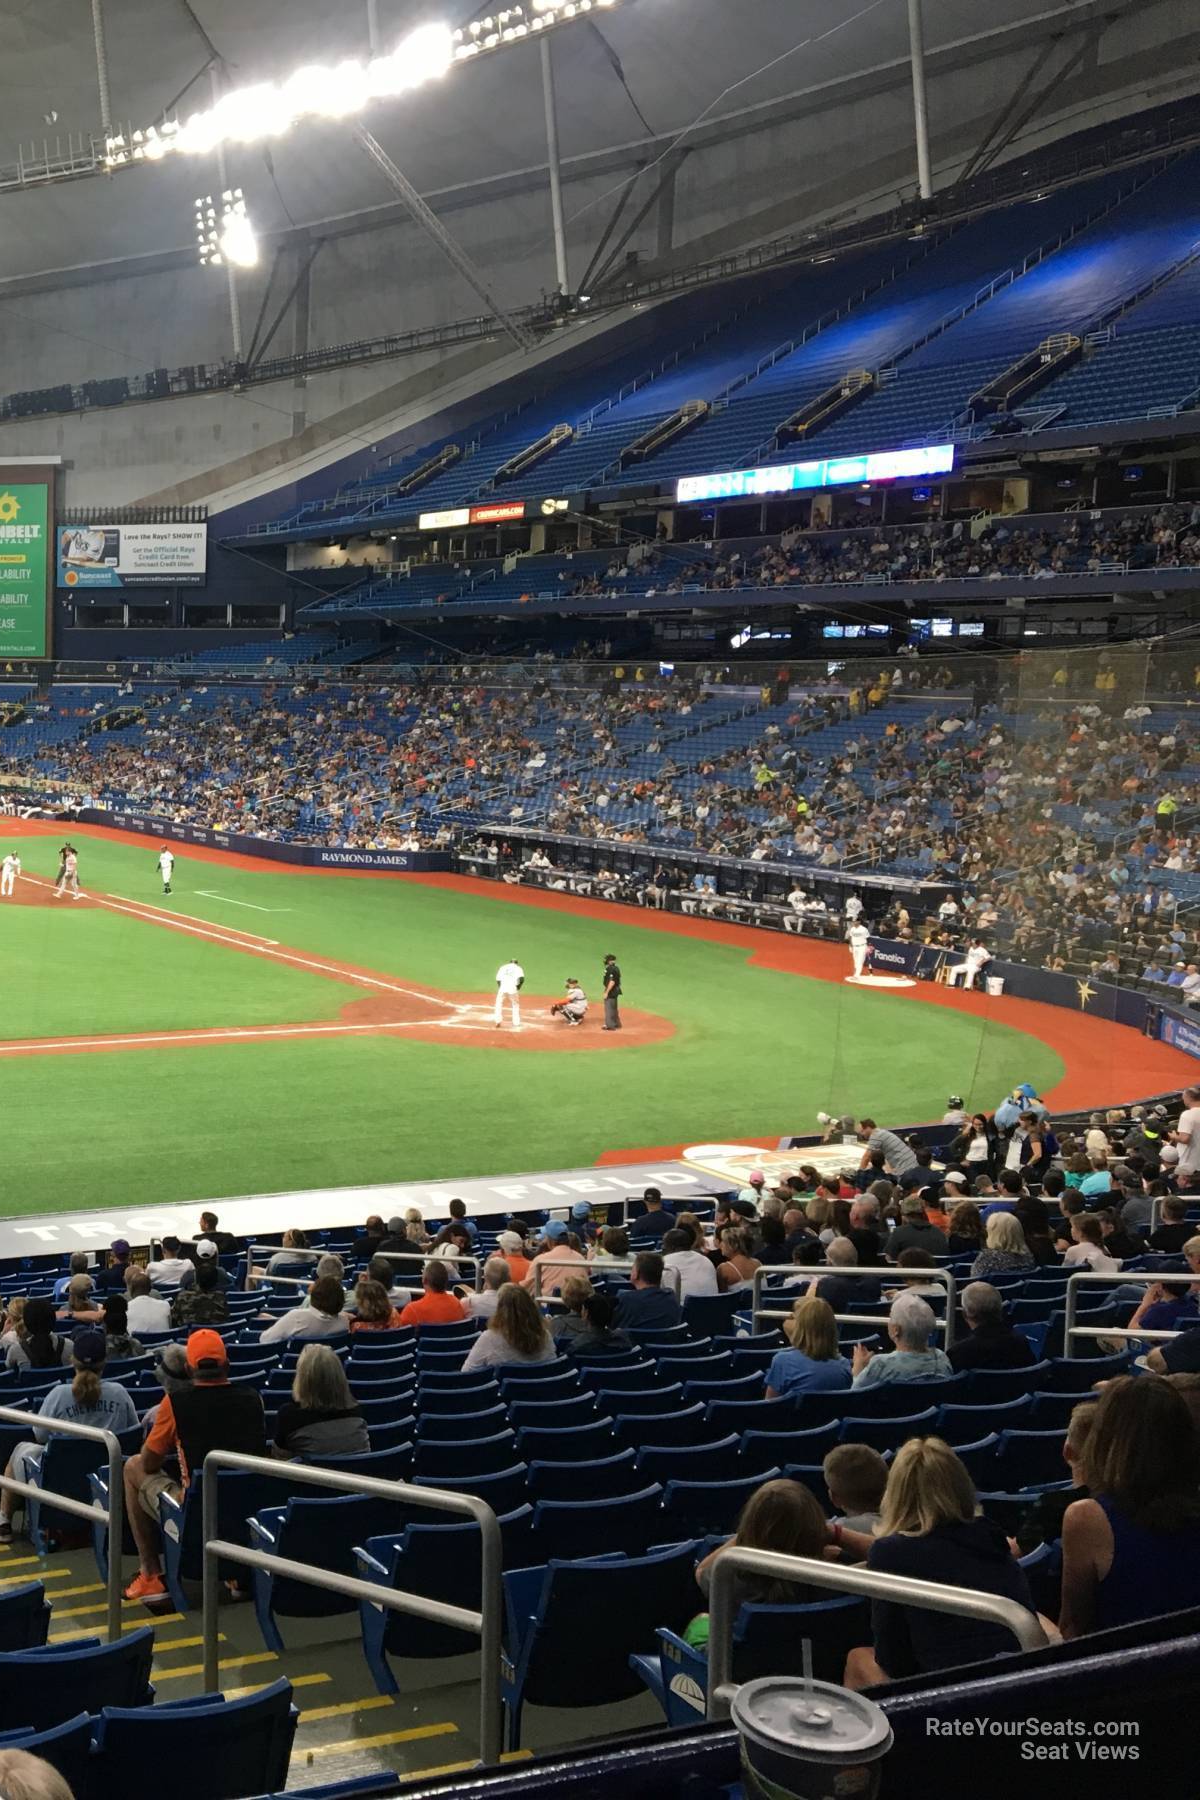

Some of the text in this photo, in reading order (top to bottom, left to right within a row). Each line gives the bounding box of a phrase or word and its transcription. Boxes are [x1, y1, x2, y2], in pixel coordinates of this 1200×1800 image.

[321, 851, 408, 867] RAYMOND JAMES
[874, 949, 906, 965] Fanatics
[487, 1171, 700, 1201] FIELD
[64, 1399, 119, 1418] CHOLET
